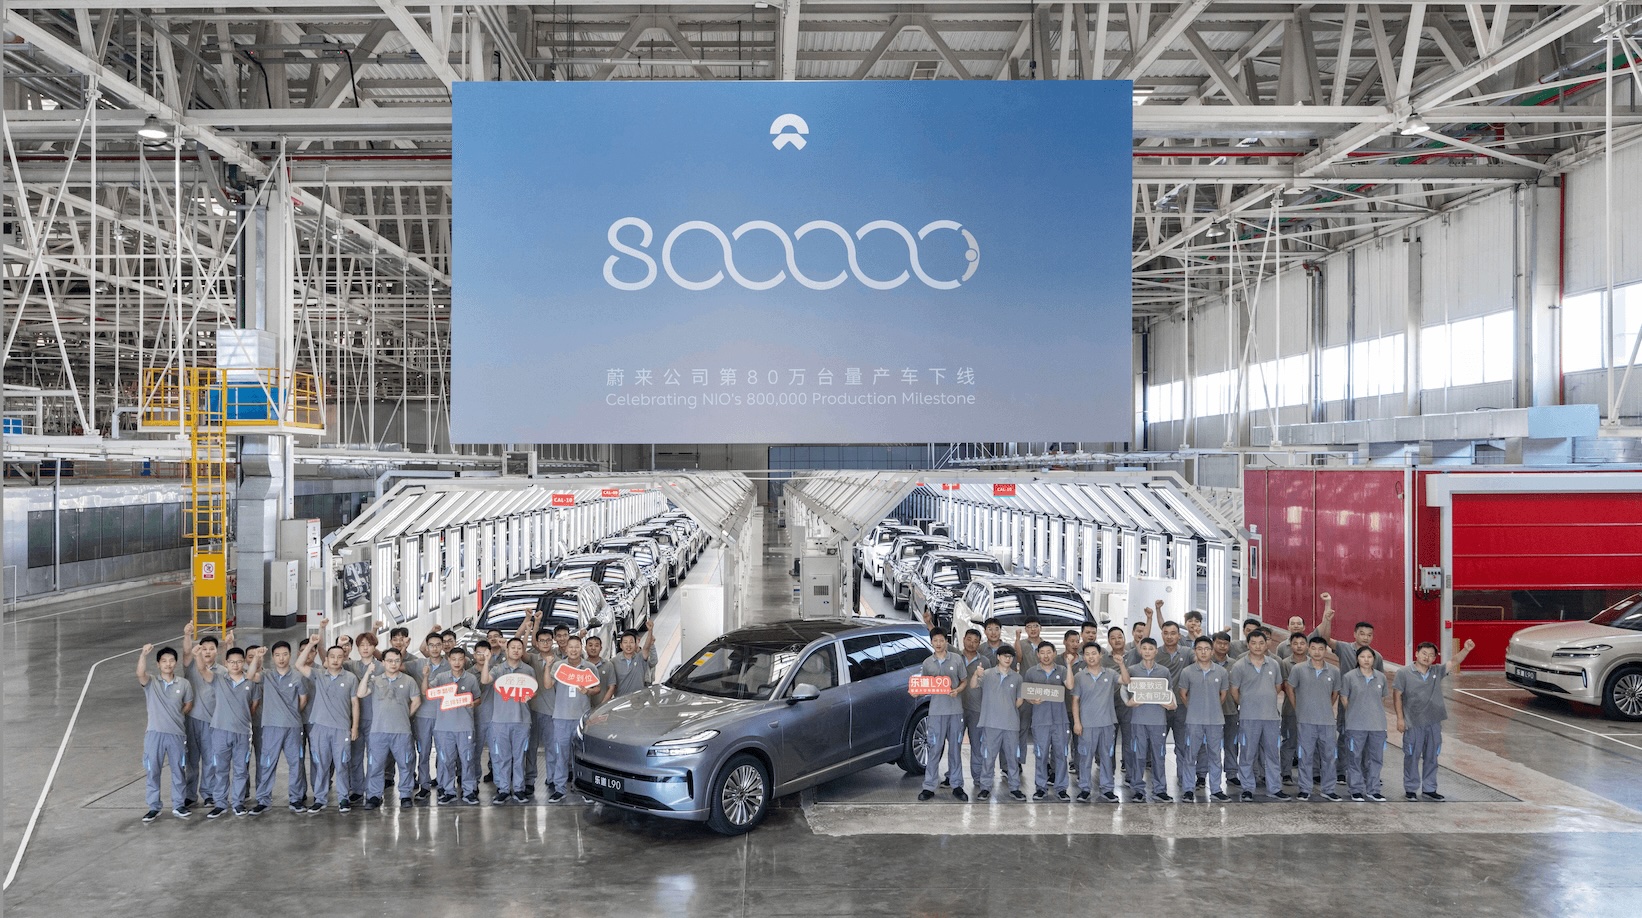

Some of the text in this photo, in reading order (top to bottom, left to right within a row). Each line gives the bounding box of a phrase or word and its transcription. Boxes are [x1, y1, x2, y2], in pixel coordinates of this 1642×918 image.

[606, 368, 975, 386] 蔚来公司第80万台量产车下线
[605, 392, 976, 409] Celebrating NIO's 800,000 Production Milestone
[560, 670, 592, 683] 一步到位
[1026, 686, 1060, 698] 空间奇迹
[1131, 681, 1163, 690] 以爱致远
[499, 686, 535, 703] VIP
[1137, 691, 1170, 700] 大有可为
